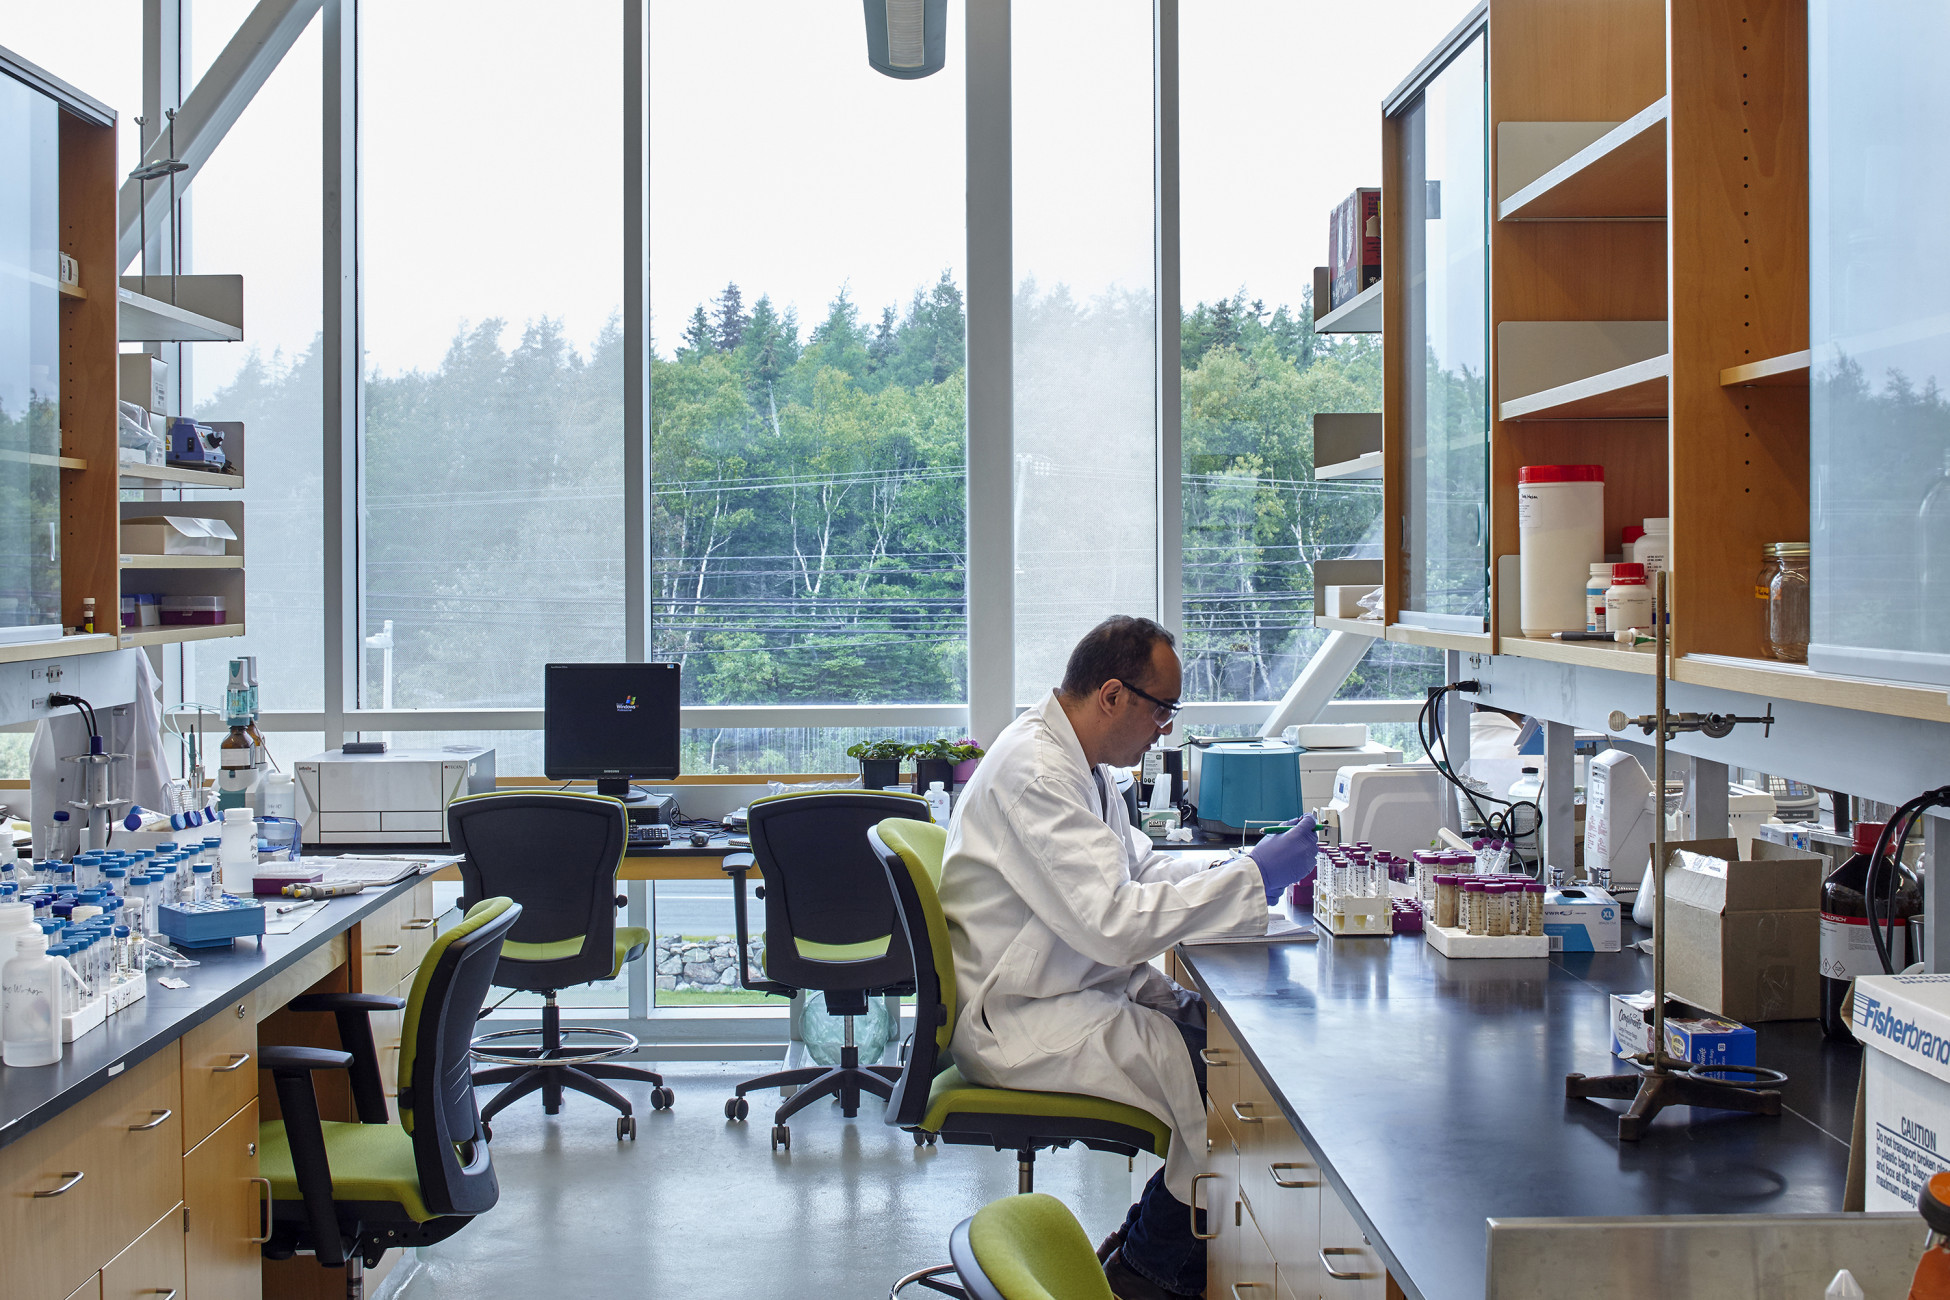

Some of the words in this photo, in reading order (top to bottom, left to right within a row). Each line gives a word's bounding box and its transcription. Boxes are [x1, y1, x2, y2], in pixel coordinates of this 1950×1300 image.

[1603, 911, 1613, 919] XL
[1864, 998, 1950, 1066] Fisherbrand
[1876, 1128, 1884, 1143] Do
[1883, 1135, 1893, 1149] not
[1893, 1138, 1917, 1161] transport
[1917, 1151, 1937, 1172] broken
[1901, 1116, 1936, 1152] CAUTION
[1876, 1160, 1885, 1174] and
[1885, 1163, 1896, 1180] box
[1895, 1171, 1902, 1183] at
[1901, 1173, 1910, 1188] the
[1911, 1180, 1922, 1194] sam
[1881, 1147, 1898, 1167] plastic
[1898, 1155, 1912, 1175] bags.
[1876, 1175, 1900, 1197] maximum
